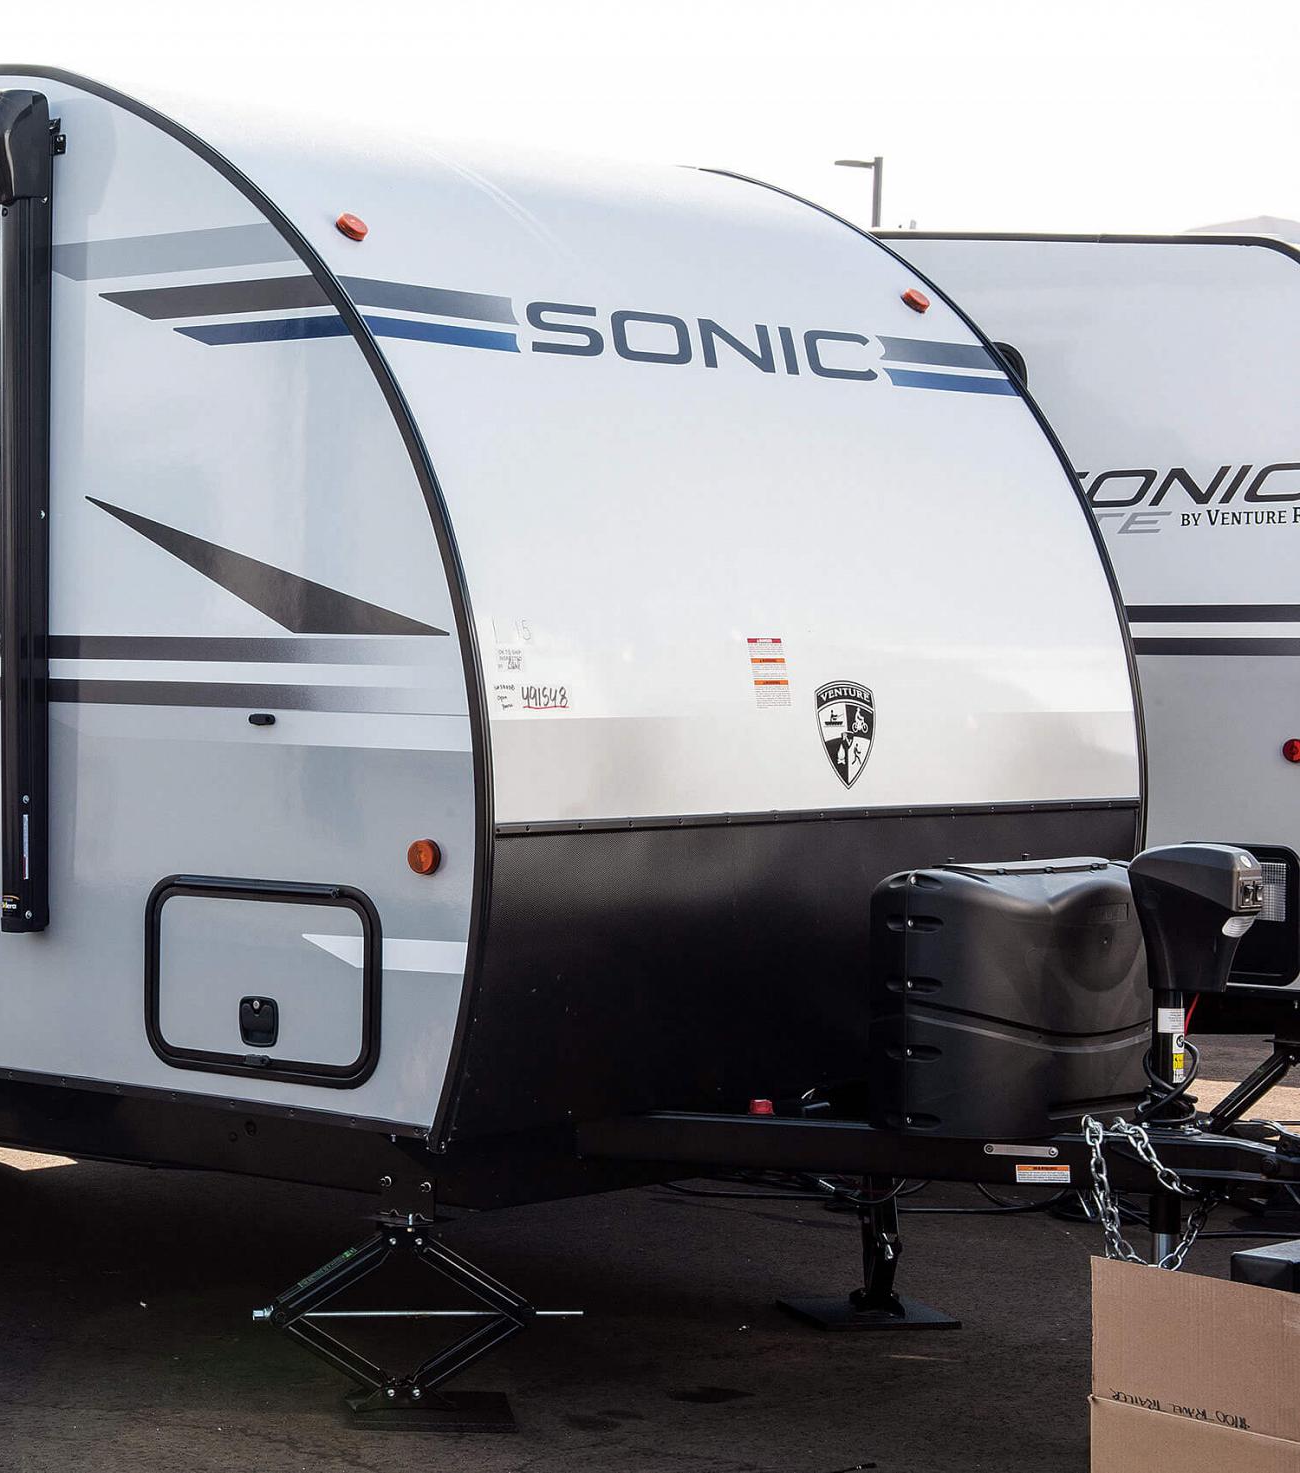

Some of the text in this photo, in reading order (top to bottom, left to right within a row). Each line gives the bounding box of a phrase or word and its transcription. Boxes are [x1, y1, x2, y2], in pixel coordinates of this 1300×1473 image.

[526, 301, 878, 381] SONIC
[1076, 462, 1300, 509] ONIC
[1180, 512, 1201, 527] BY
[820, 687, 871, 702] VENTURE
